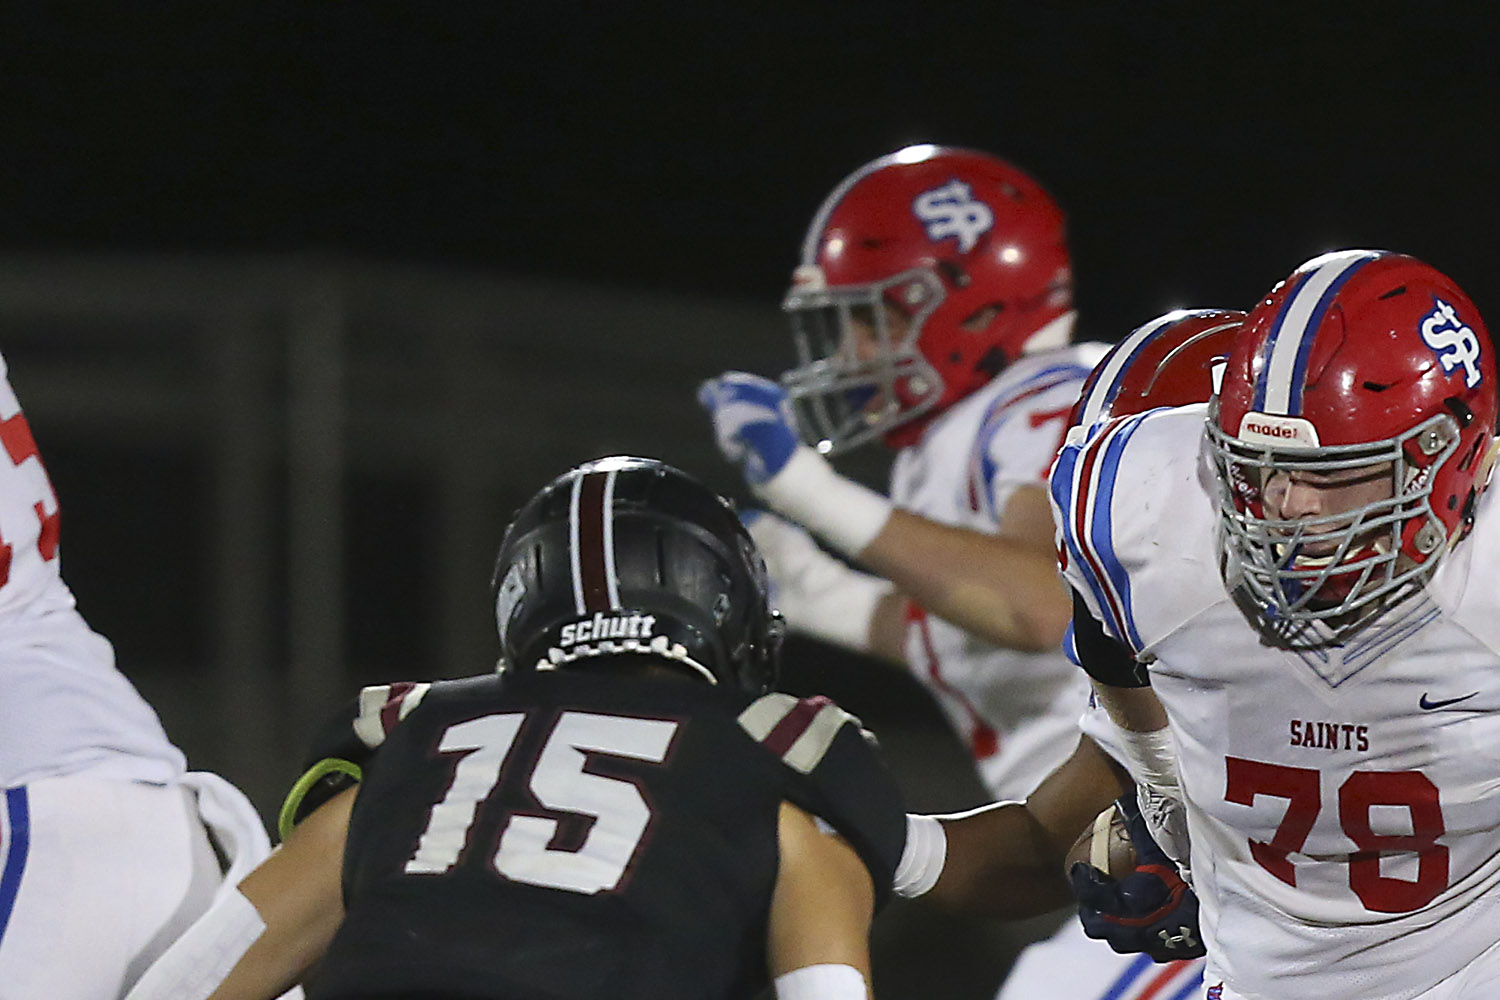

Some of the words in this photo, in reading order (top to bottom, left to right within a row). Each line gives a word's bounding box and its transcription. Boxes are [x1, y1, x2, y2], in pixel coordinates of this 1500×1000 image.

[404, 710, 680, 897] 15
[1289, 719, 1370, 752] SAINTS
[1224, 755, 1451, 914] 78
